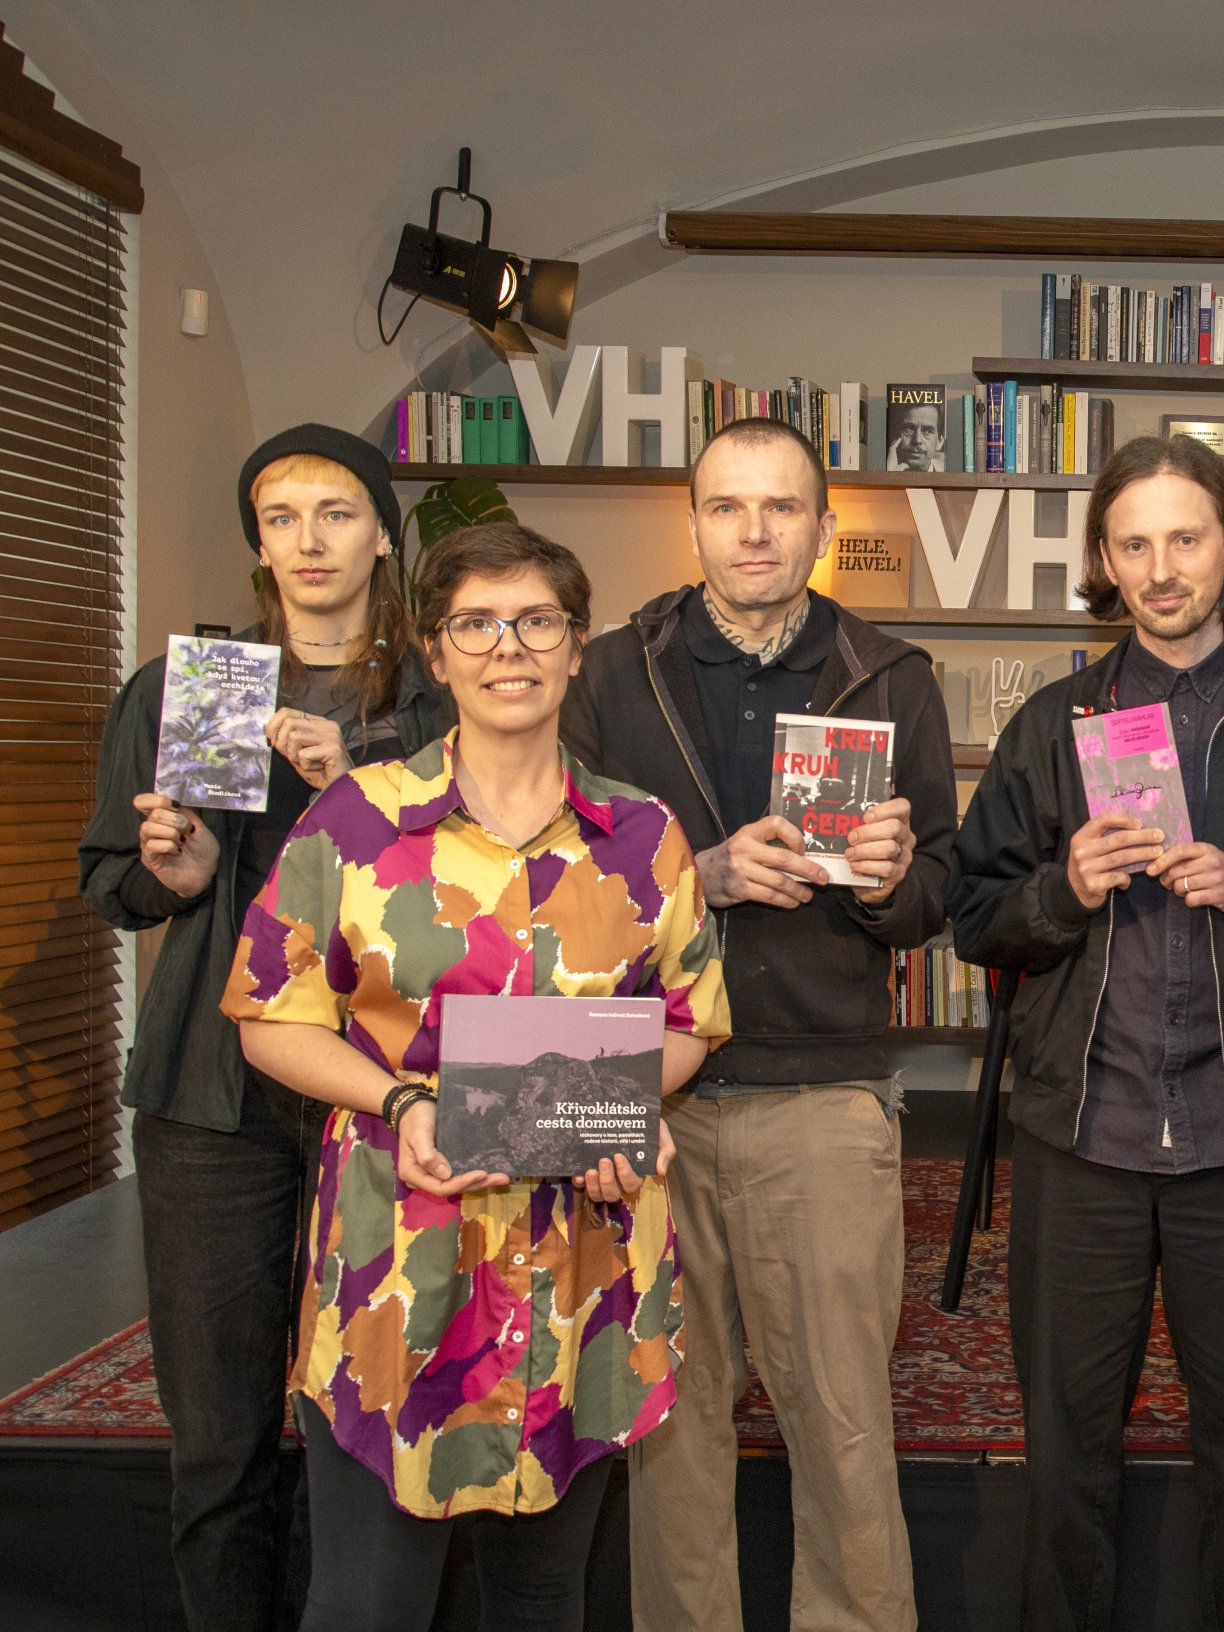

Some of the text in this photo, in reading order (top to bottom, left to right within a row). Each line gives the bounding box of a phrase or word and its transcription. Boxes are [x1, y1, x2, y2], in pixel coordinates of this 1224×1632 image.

[890, 390, 943, 404] HAVEL
[837, 537, 889, 557] HELE,
[836, 555, 902, 573] HAVEL!
[211, 655, 260, 667] Jak dlouho
[231, 673, 261, 683] kvetou
[221, 681, 265, 693] orchideje
[825, 727, 890, 753] KREV
[773, 751, 839, 777] KRUH
[555, 1101, 647, 1116] Křivoklátsko
[535, 1116, 646, 1129] cesta domovem
